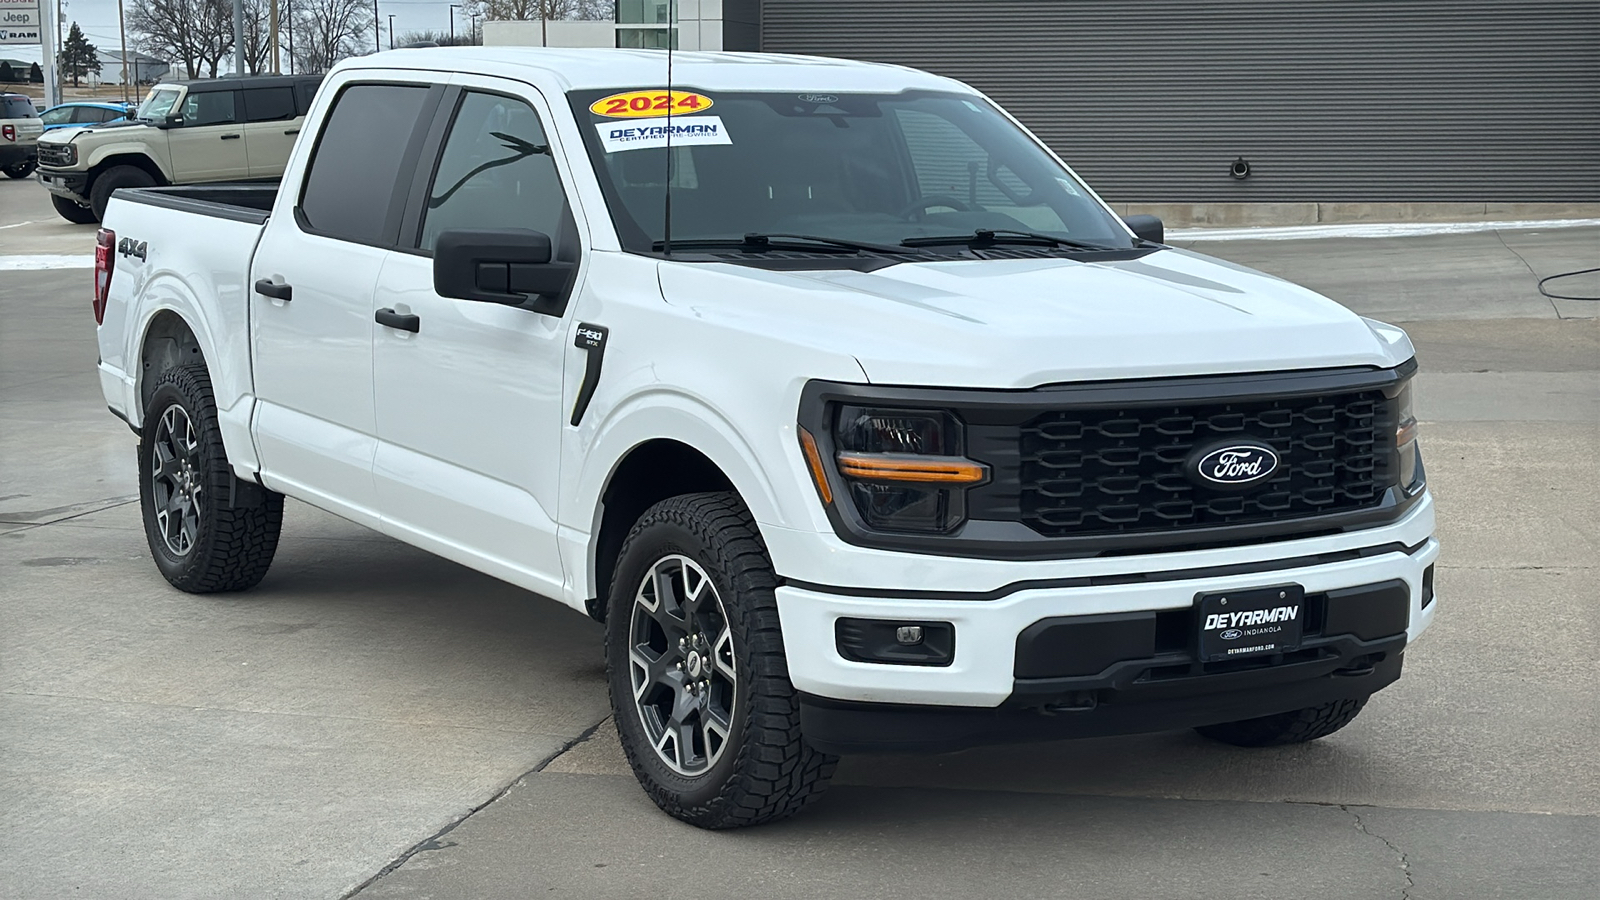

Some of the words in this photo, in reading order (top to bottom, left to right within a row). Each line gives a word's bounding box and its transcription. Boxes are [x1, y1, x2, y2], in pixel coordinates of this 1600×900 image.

[3, 11, 30, 24] Jeep
[605, 95, 701, 114] 2024
[610, 124, 717, 139] DEYARMAN
[620, 134, 665, 142] CERTIFIED
[577, 328, 602, 340] F-150
[1214, 451, 1263, 478] Ford
[1204, 605, 1298, 630] DEYARMAN
[1244, 625, 1282, 636] INDIANOLA
[1227, 644, 1274, 654] DEYARMANFORD.COM
